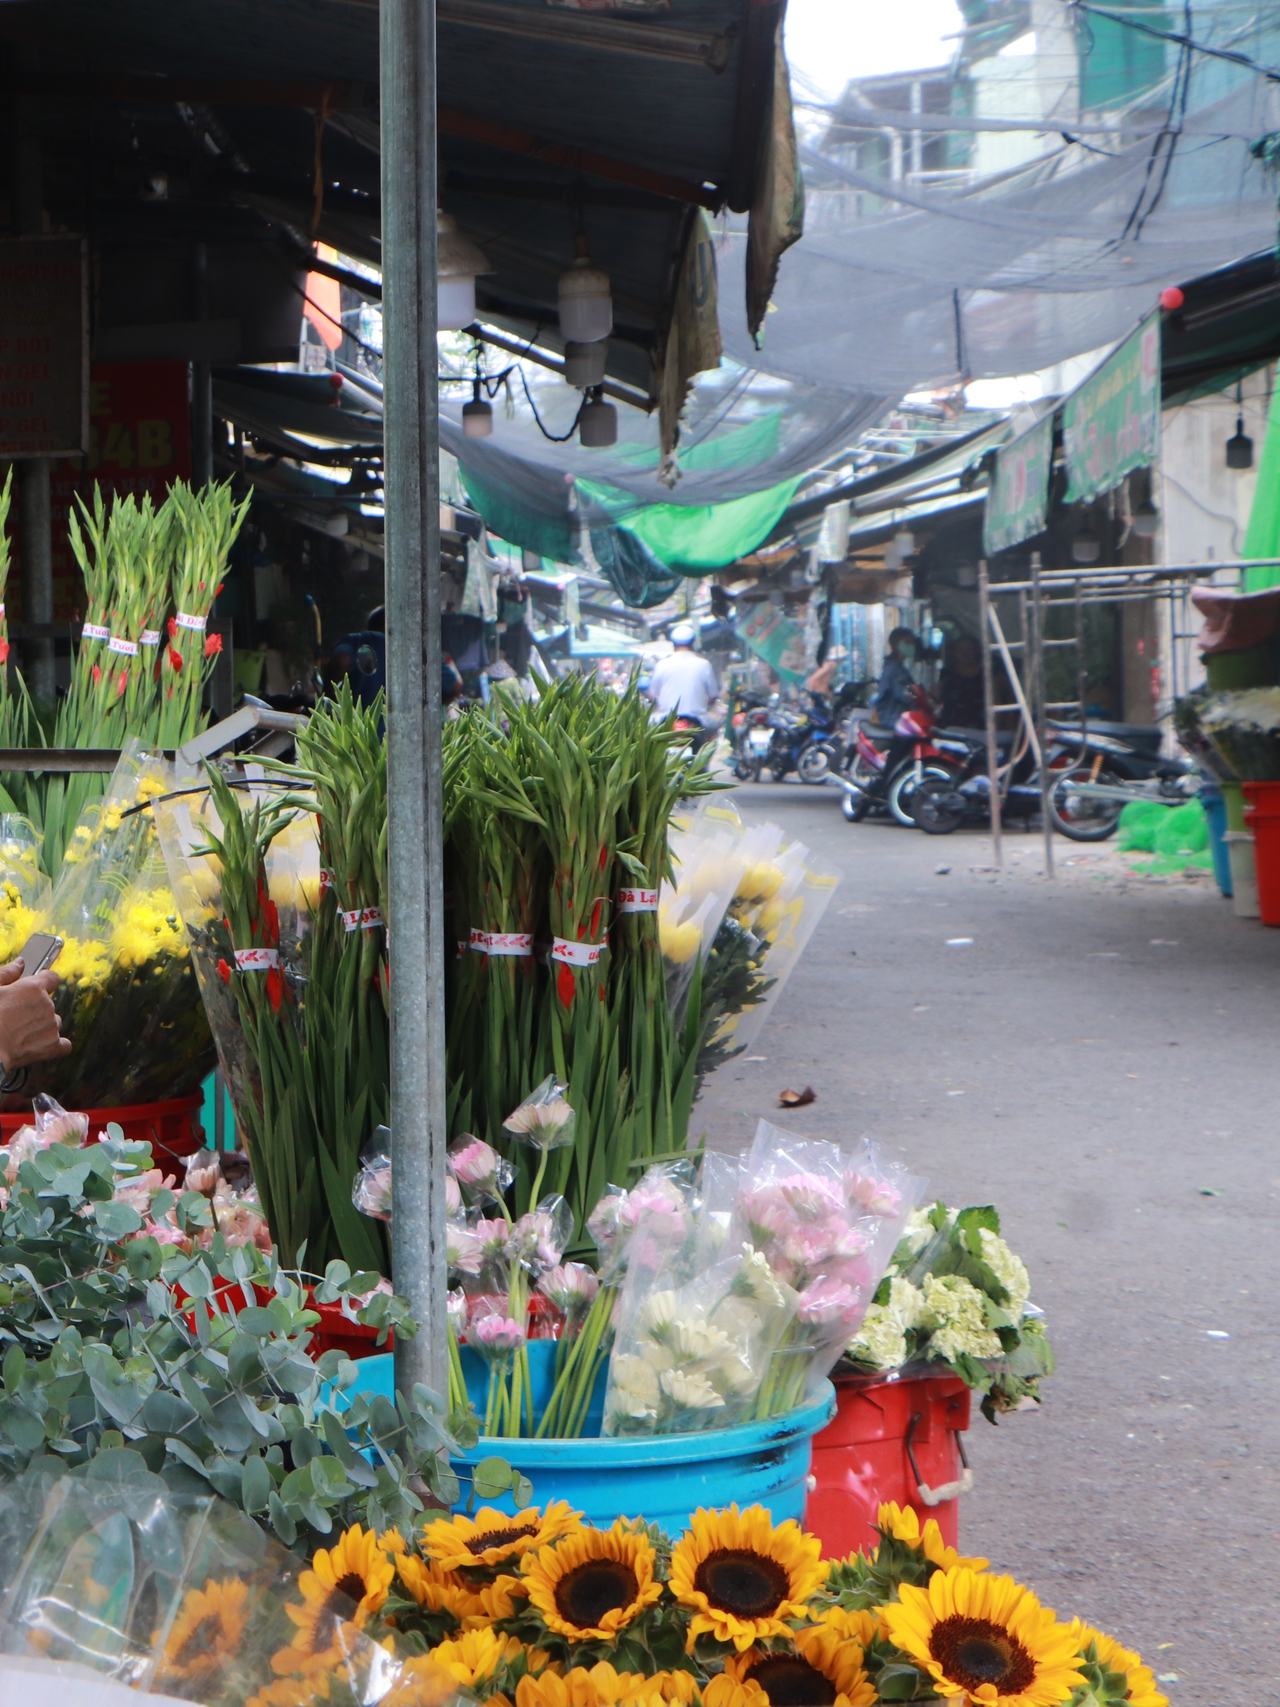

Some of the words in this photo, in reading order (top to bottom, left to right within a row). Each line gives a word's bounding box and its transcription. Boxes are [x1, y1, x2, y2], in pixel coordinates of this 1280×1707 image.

[18, 364, 52, 380] GEL
[17, 418, 52, 434] GEL
[619, 890, 635, 903] Đà
[640, 891, 657, 906] Lạ
